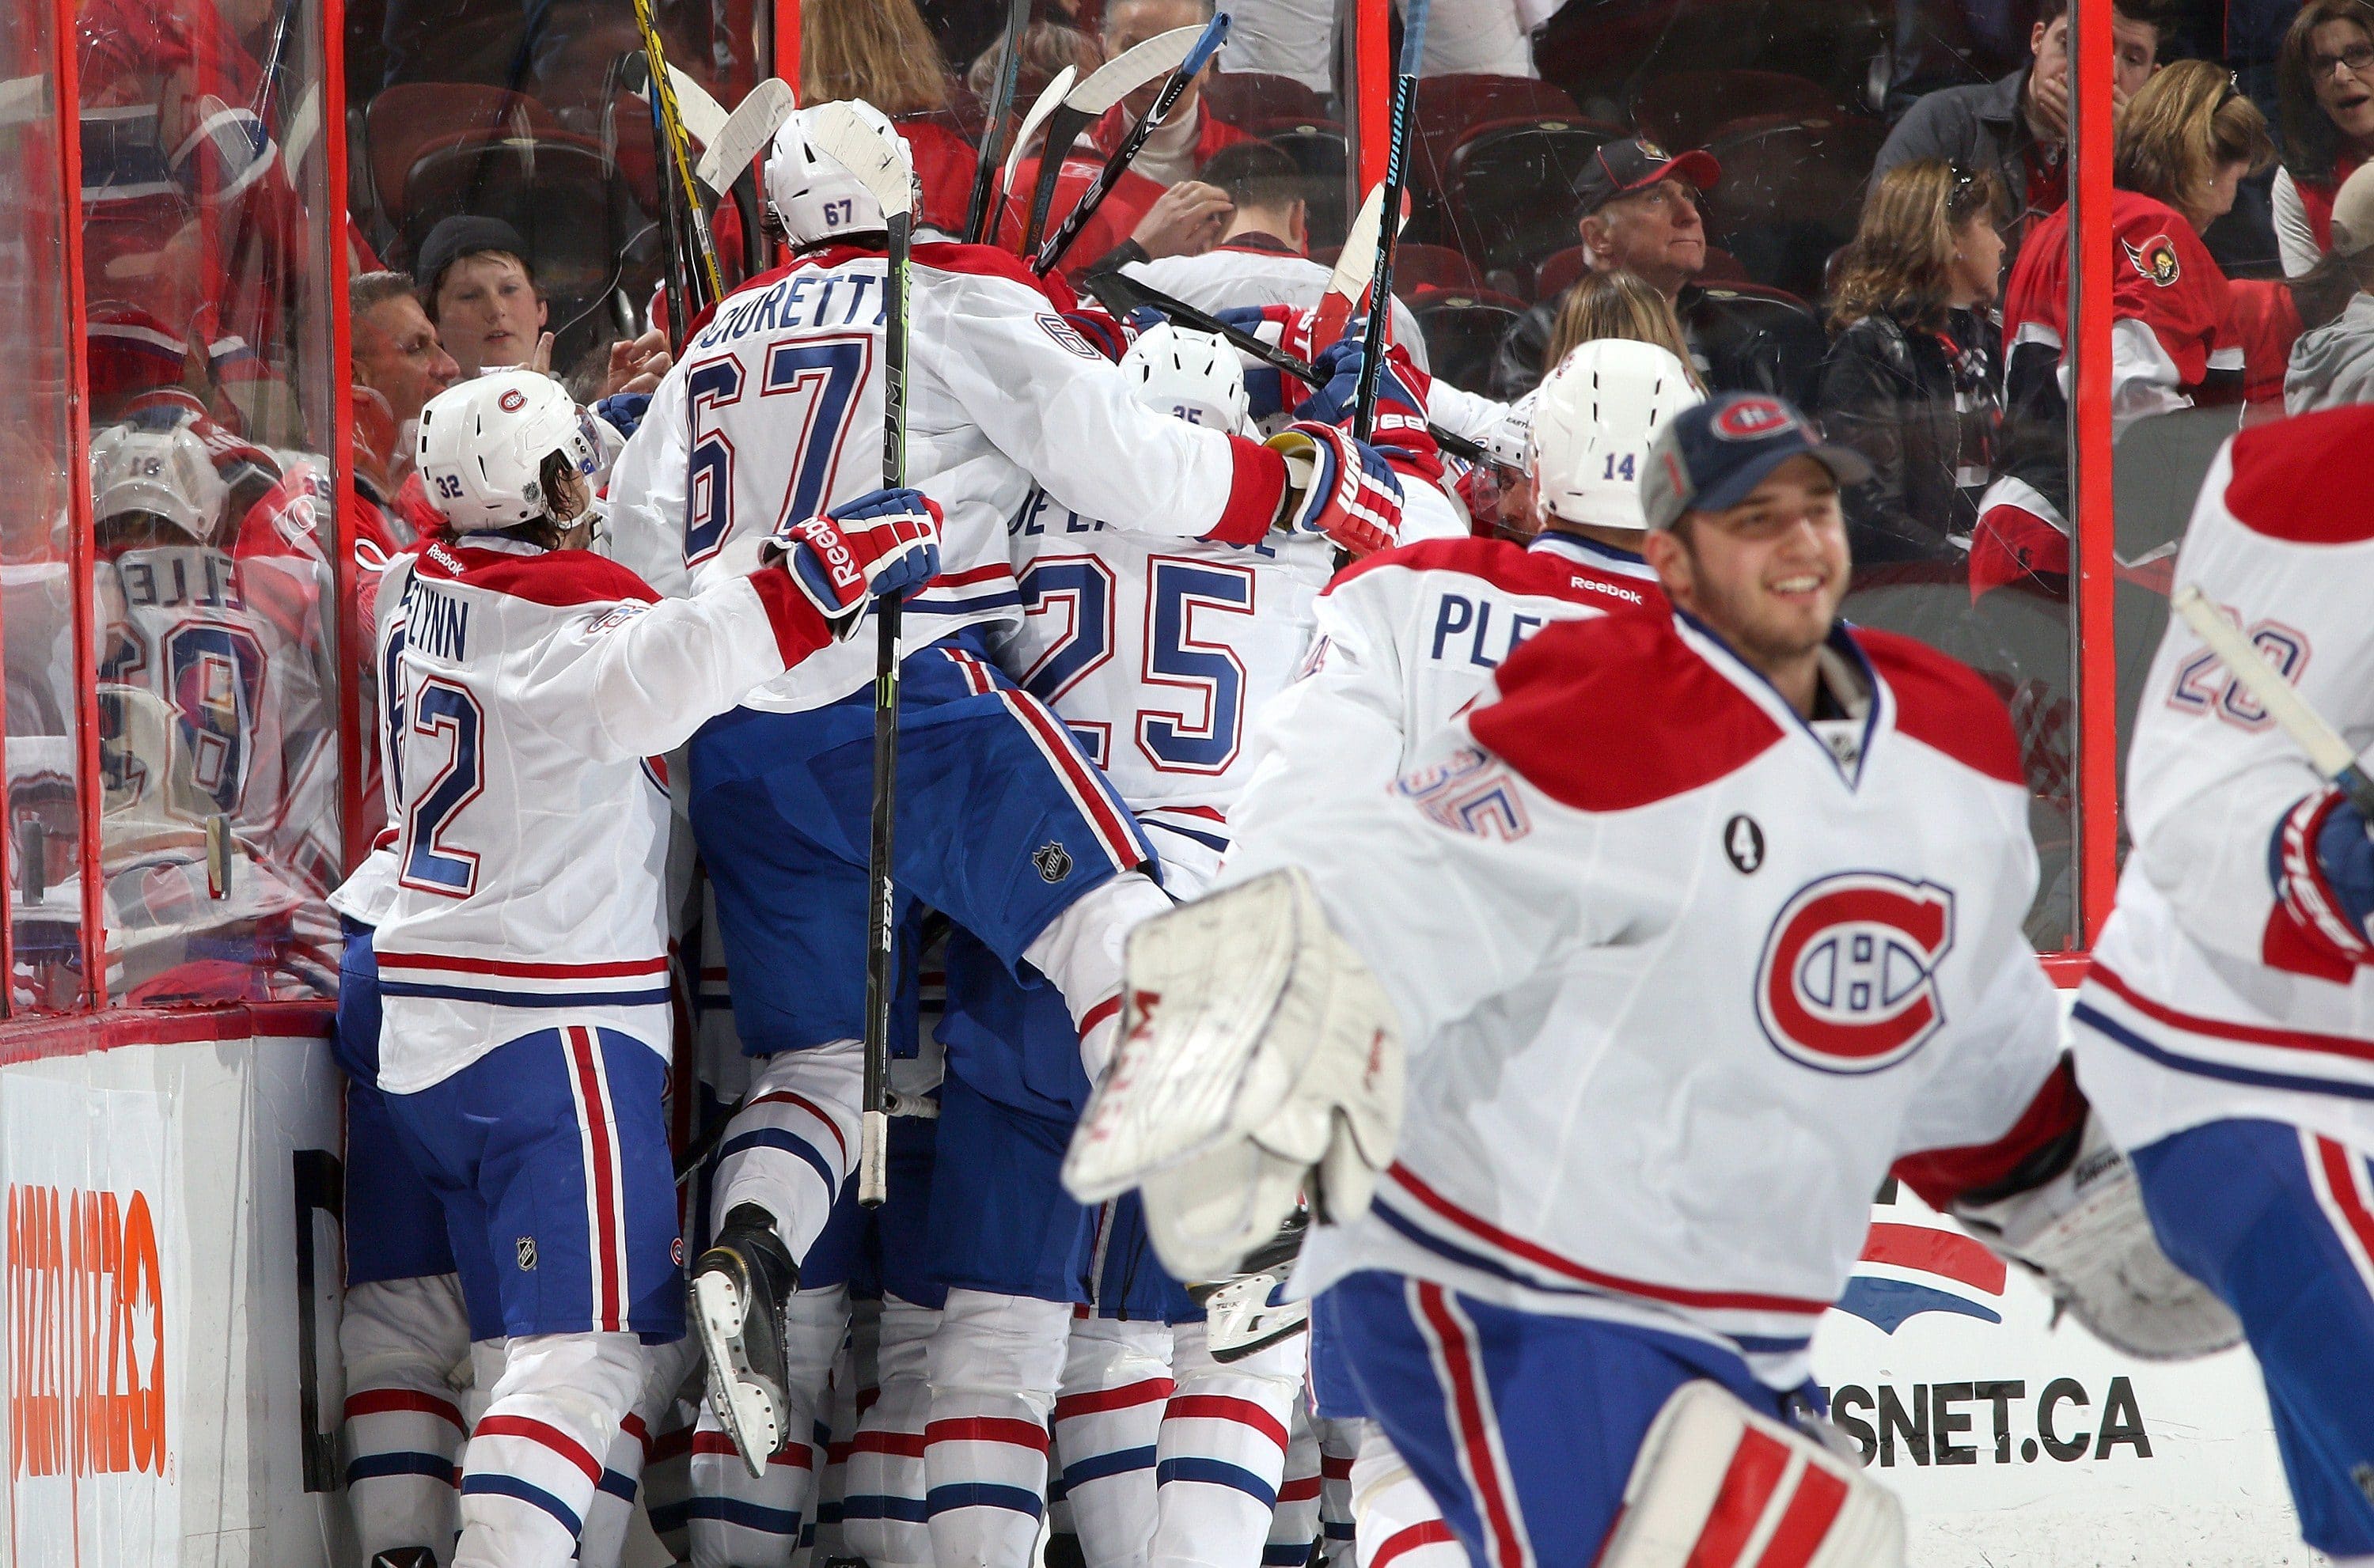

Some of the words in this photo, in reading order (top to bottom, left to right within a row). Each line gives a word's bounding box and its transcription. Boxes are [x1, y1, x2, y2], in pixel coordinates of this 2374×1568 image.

[1384, 75, 1408, 187] WARRIOR
[823, 199, 852, 226] 67
[435, 474, 463, 499] 32
[681, 332, 872, 570] 67
[1602, 452, 1634, 482] 14
[426, 543, 465, 577] Reebok
[795, 515, 863, 589] Reebo
[408, 581, 469, 663] LYNN
[1570, 576, 1644, 605] Reebok
[1012, 552, 1257, 776] 25
[1728, 815, 1760, 873] 4
[882, 874, 894, 953] CCM
[1819, 1376, 2153, 1468] SNET.CA
